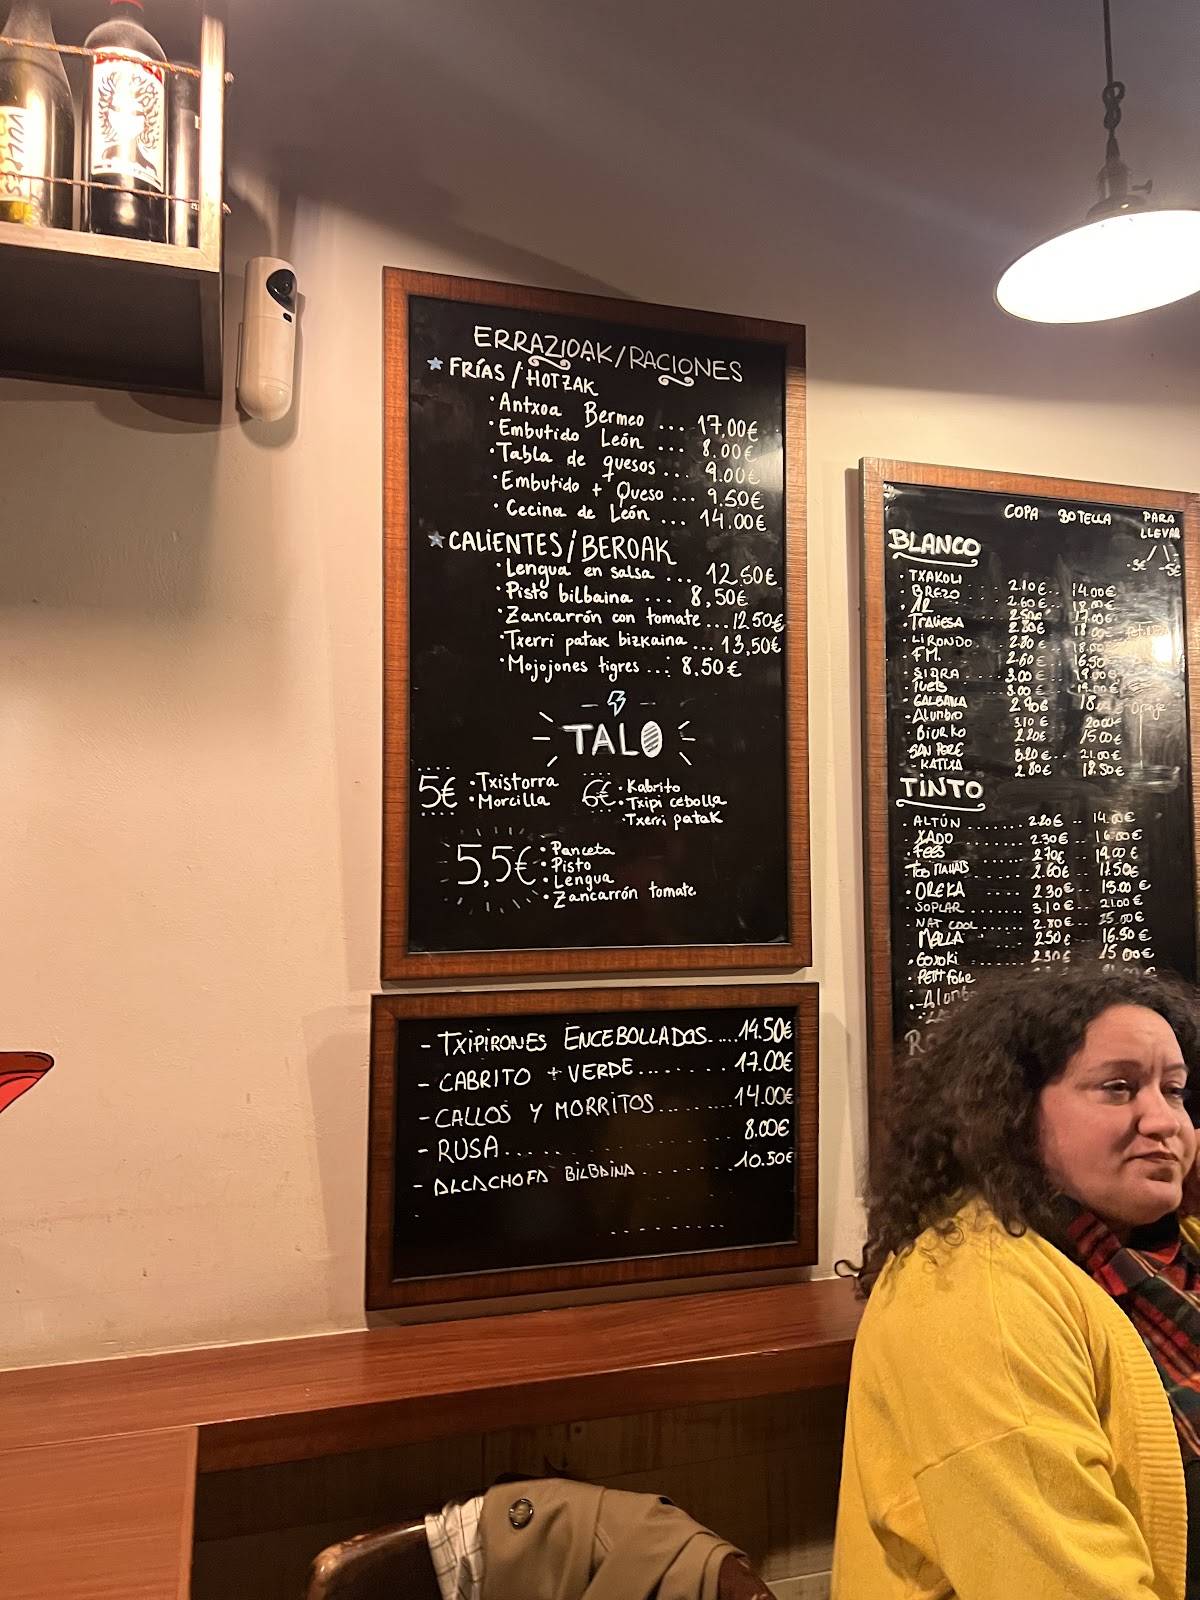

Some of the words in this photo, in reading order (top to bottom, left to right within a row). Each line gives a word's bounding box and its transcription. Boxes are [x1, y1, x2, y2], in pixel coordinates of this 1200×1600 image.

[500, 391, 563, 417] Antxoa
[584, 400, 645, 428] Bermeo
[499, 417, 580, 442] Embutido
[600, 427, 645, 449] León
[702, 438, 757, 463] 8.00€
[496, 441, 553, 465] Tabla
[566, 449, 586, 468] de
[602, 455, 656, 482] quesos
[704, 461, 761, 485] 9.00€
[501, 469, 580, 493] Embutido
[592, 482, 603, 498] +
[616, 481, 665, 509] Queso
[707, 487, 765, 511] 9.50€
[506, 498, 567, 517] Cecina
[577, 504, 597, 520] de
[609, 503, 651, 523] León
[699, 508, 767, 532] 14.00€
[1003, 503, 1039, 521] COPA
[1057, 508, 1112, 526] BOTELLA
[1142, 510, 1176, 525] PARA
[888, 528, 982, 557] BLANCO
[506, 557, 572, 589] Lengua
[583, 565, 603, 577] en
[610, 564, 656, 580] salsa
[908, 569, 963, 585] TXAKOLI
[1008, 579, 1048, 596] 2.10€
[1072, 582, 1118, 599] 14.00€
[505, 580, 549, 600] Pisto
[558, 582, 634, 604] bilbaina
[1006, 595, 1049, 609] 2.60€
[505, 605, 603, 625] Zancarrón
[611, 613, 636, 624] con
[646, 606, 702, 627] tomate
[503, 628, 555, 650] Txerri
[565, 630, 611, 657] patak
[618, 630, 689, 649] bizkaina
[507, 653, 589, 683] Mojojones
[597, 655, 640, 683] tigres
[681, 655, 743, 678] 8.50€
[561, 720, 664, 759] TALO
[418, 774, 458, 809] 5€
[475, 771, 560, 793] Txistorra
[581, 779, 617, 808] 6€
[626, 777, 681, 794] Kabrito
[899, 772, 985, 800] TINTO
[478, 792, 551, 810] Morcilla
[625, 794, 664, 813] Txipi
[669, 794, 728, 809] cebolla
[624, 812, 668, 827] Txerri
[673, 810, 724, 832] patak
[1029, 830, 1070, 846] 2.30€
[457, 843, 537, 889] 5,5€
[550, 840, 616, 857] Panceta
[550, 857, 592, 874] Pisto
[552, 885, 639, 910] Zancarrón
[648, 880, 697, 900] tomate
[553, 872, 615, 892] Lengua
[914, 901, 966, 914] SOPLAR
[437, 1027, 548, 1057] TXIPIRONES
[563, 1025, 708, 1051] ENCEBOLLADOS
[438, 1067, 532, 1092] CABRITO
[567, 1057, 634, 1083] VERDE
[734, 1049, 794, 1073] 17.00€
[434, 1103, 512, 1129] CALLOS
[734, 1084, 794, 1108] 14.00€
[438, 1135, 500, 1164] RUSA
[744, 1118, 790, 1140] 8.00€
[433, 1168, 549, 1197] ALCACHOFA
[733, 1150, 794, 1168] 10.50€
